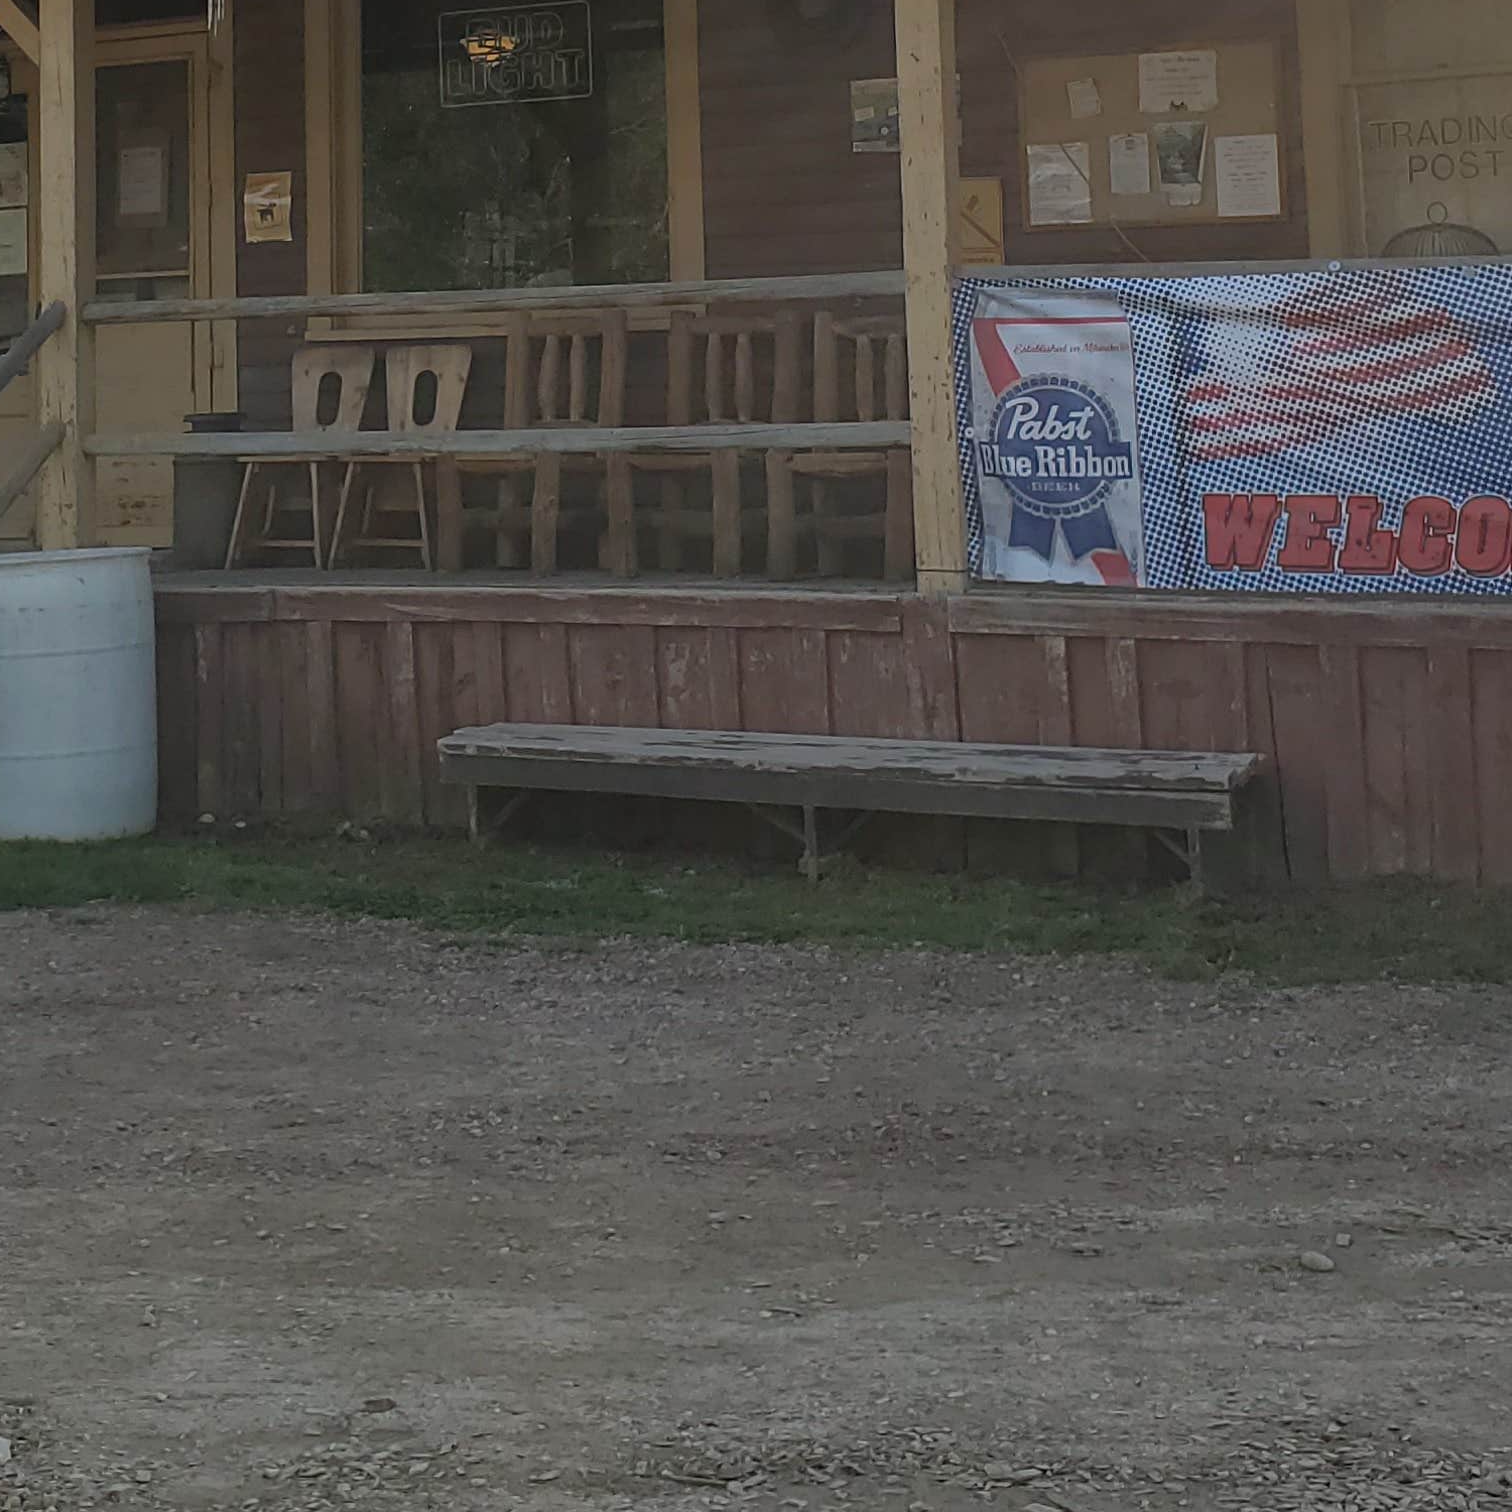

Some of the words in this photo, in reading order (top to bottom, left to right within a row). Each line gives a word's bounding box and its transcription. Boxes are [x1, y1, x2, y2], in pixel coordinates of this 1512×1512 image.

[1409, 150, 1505, 184] POST
[1005, 396, 1095, 441] Pabst
[981, 443, 1033, 477] Blue
[1034, 445, 1131, 477] Ribbon
[1201, 493, 1512, 578] WELCO
